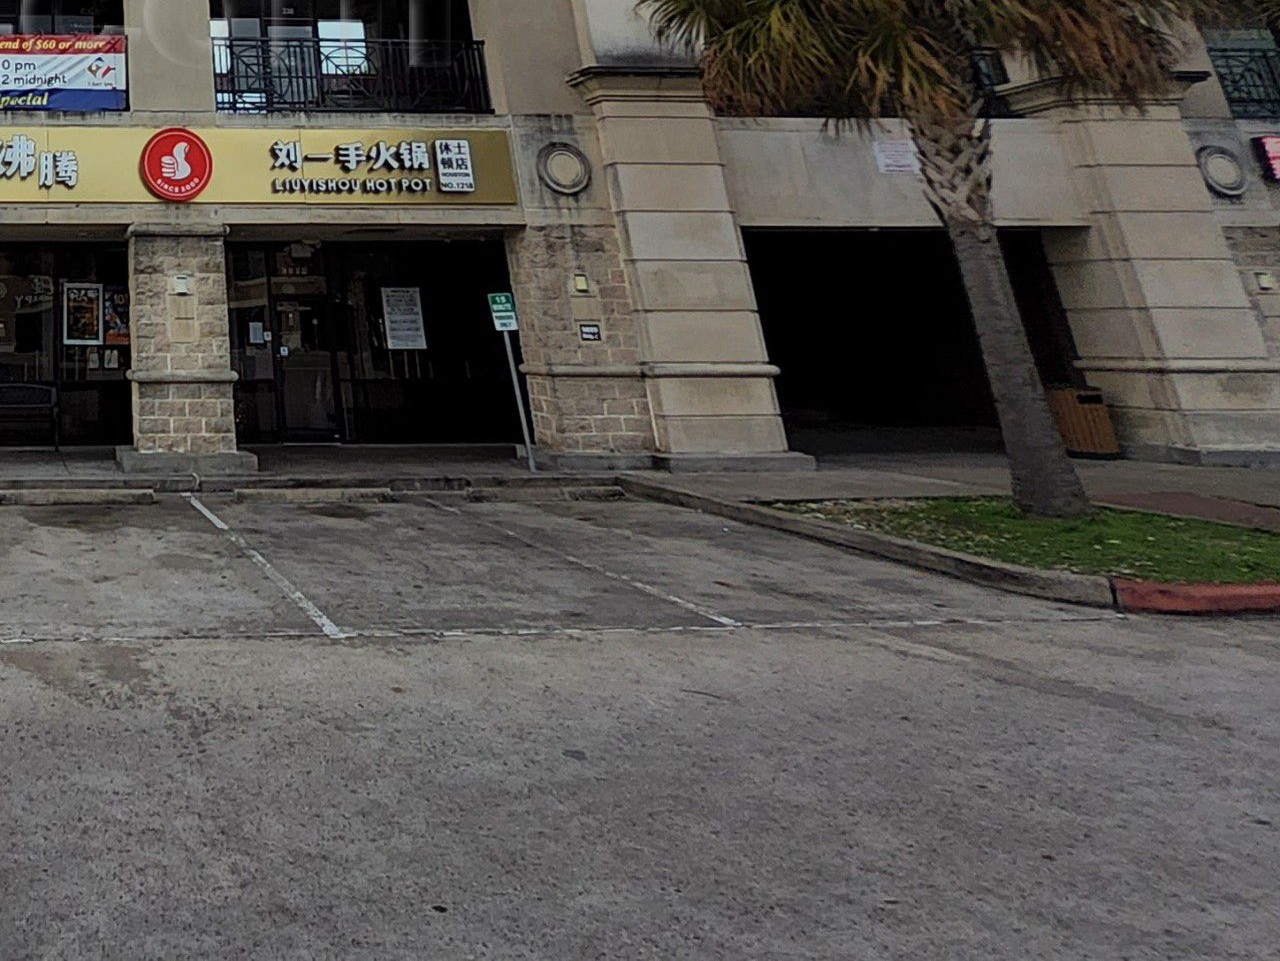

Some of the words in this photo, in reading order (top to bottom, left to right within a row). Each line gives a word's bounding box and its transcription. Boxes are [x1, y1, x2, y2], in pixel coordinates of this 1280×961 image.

[22, 38, 34, 51] of
[36, 39, 56, 50] $60
[58, 41, 72, 49] or
[15, 62, 36, 73] pm
[14, 73, 68, 87] midnight
[272, 140, 430, 170] 刘一手火锅
[275, 178, 361, 191] LIUYISHOU
[366, 178, 397, 191] HOT
[402, 178, 432, 191] POT
